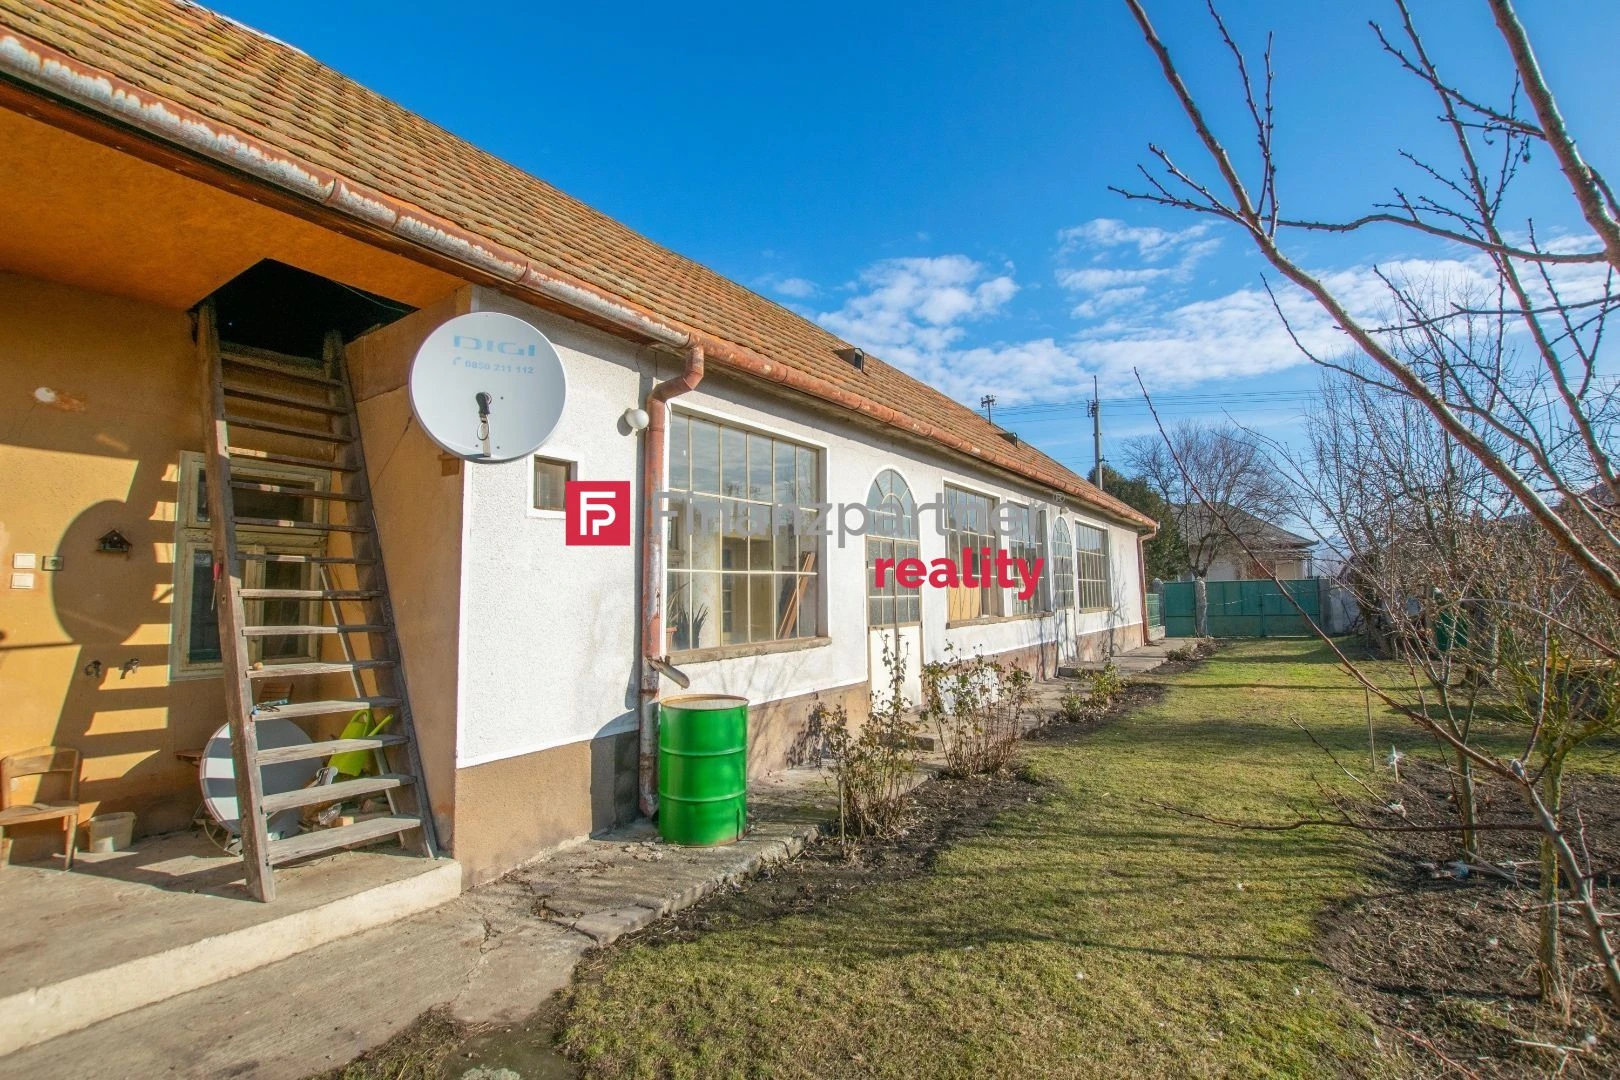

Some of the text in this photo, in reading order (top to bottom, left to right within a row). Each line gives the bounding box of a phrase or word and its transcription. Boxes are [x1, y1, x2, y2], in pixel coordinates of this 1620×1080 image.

[454, 335, 536, 357] DIGI
[494, 363, 512, 373] 211
[516, 366, 534, 375] 112
